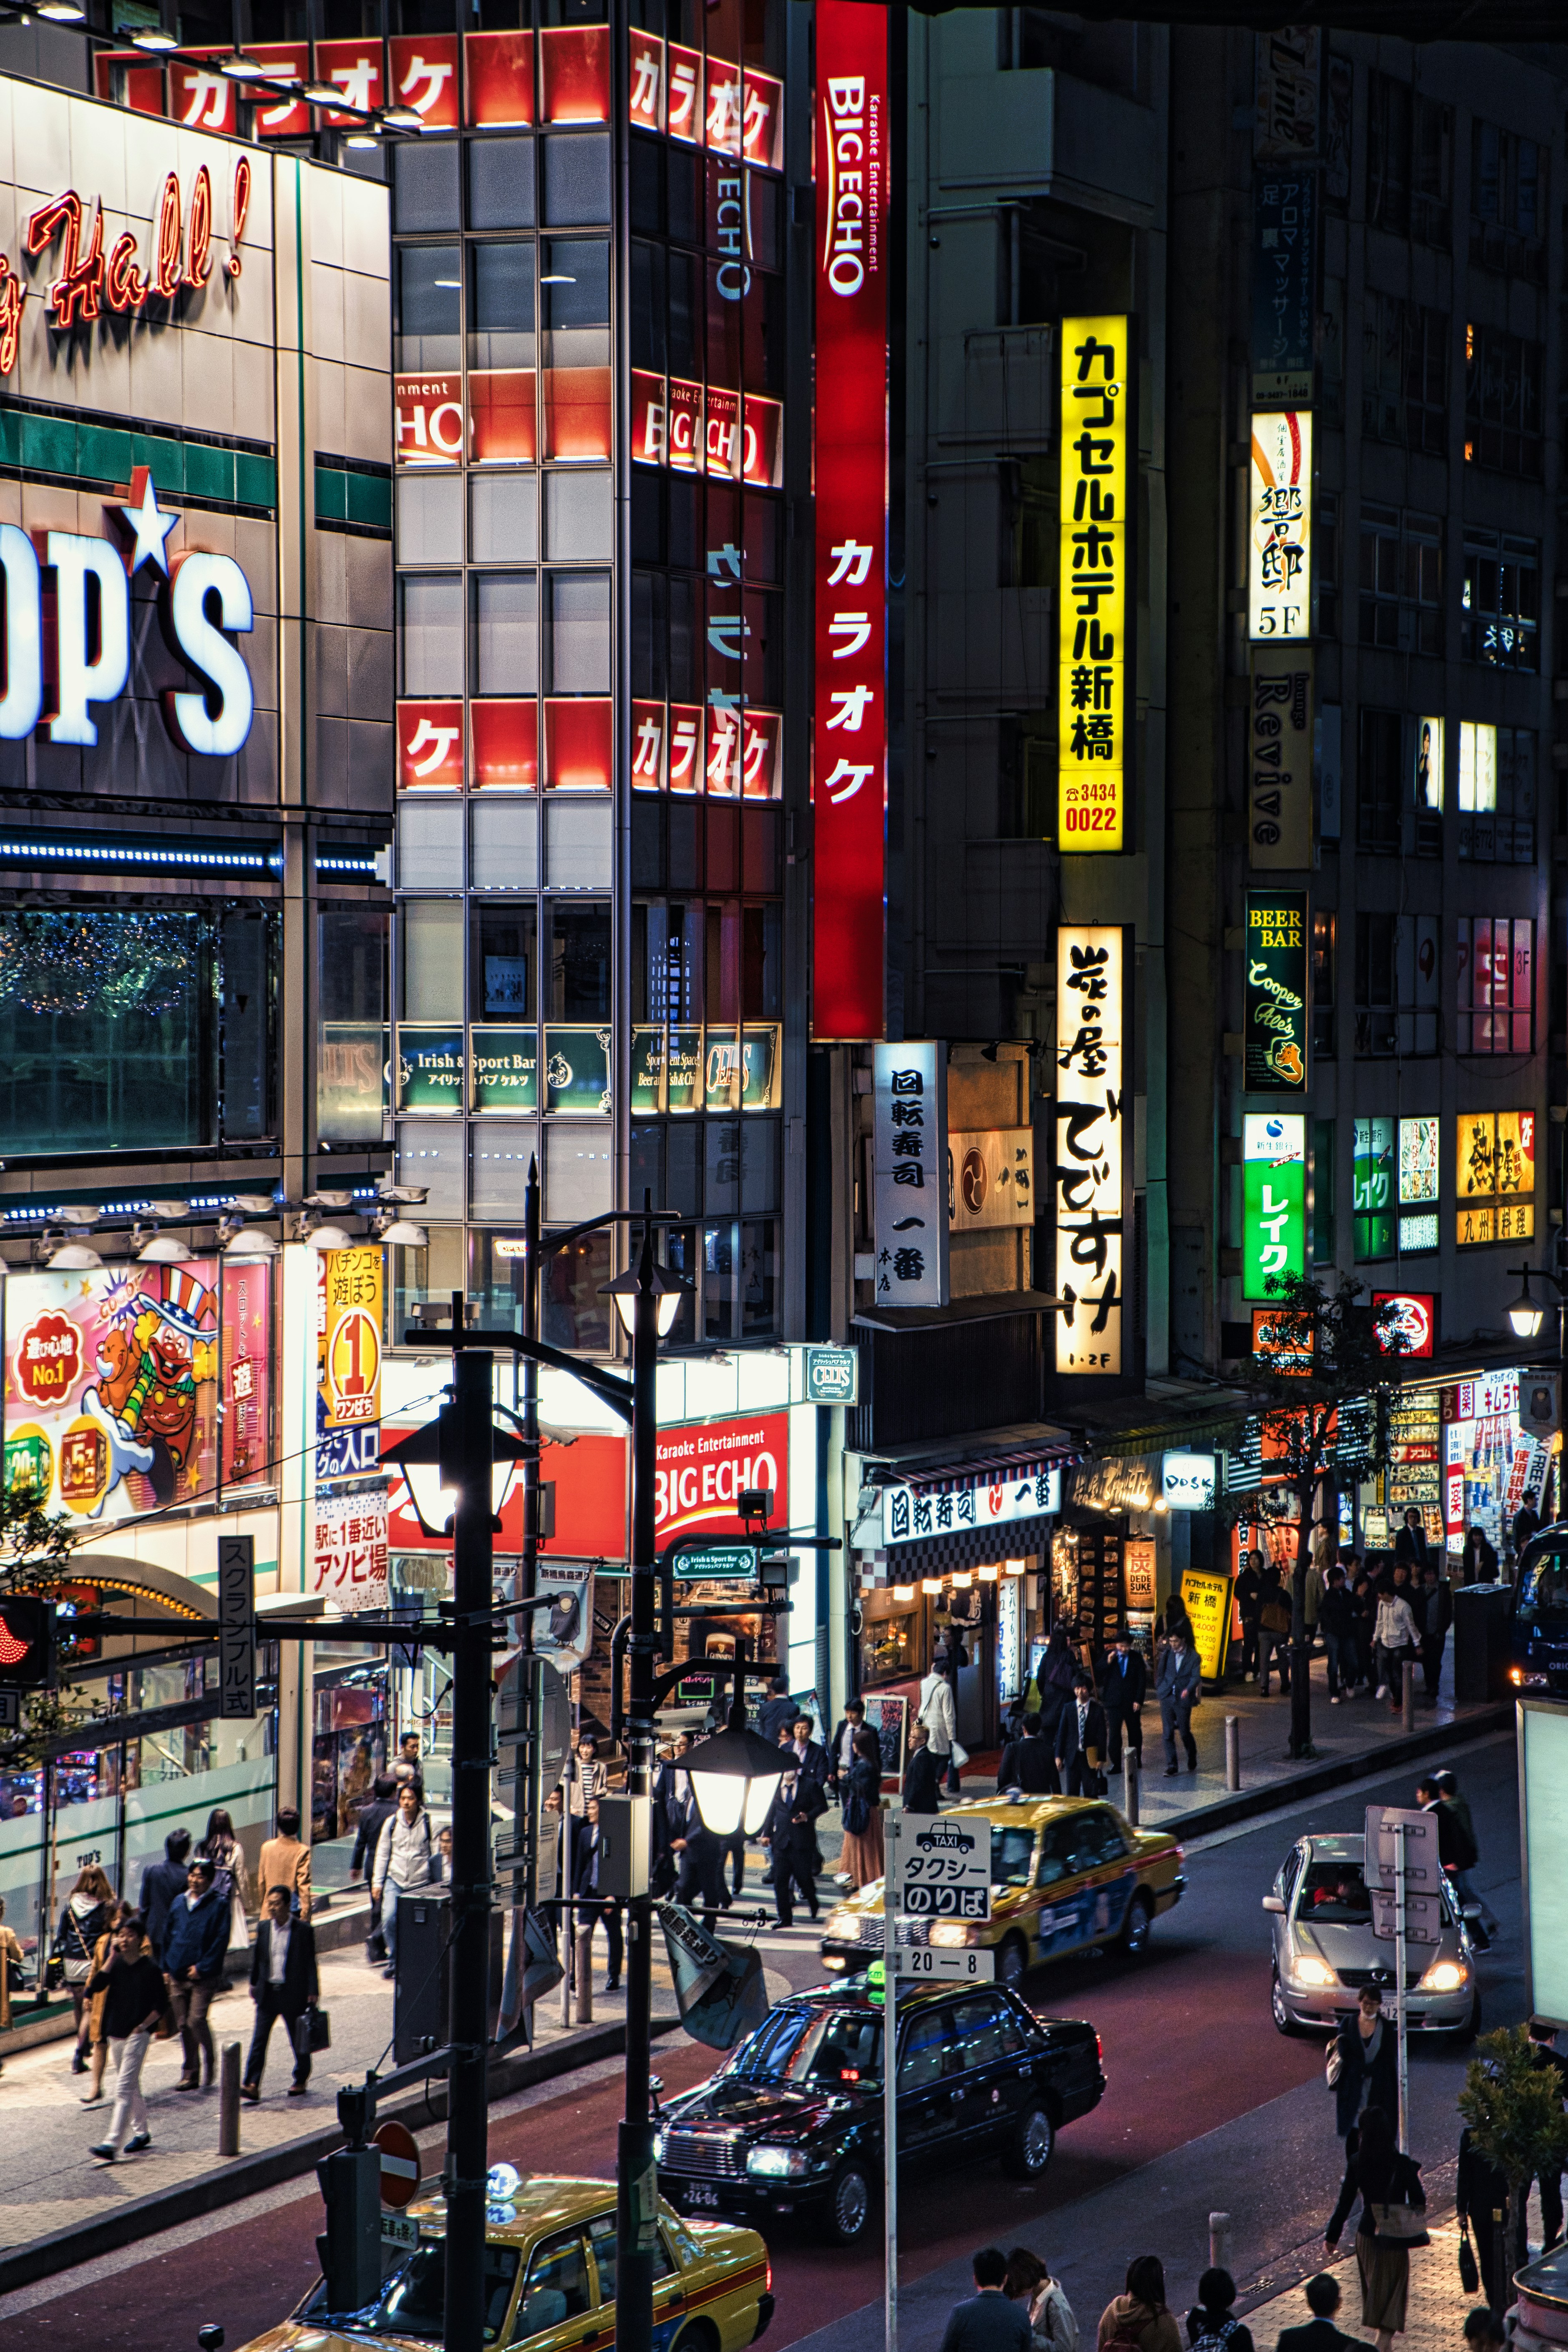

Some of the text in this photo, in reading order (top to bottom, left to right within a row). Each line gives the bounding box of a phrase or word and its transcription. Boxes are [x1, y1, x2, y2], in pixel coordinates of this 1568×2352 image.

[184, 54, 453, 128] カラオケ
[631, 51, 770, 148] カラオケ
[827, 76, 865, 297] BIG ECHO
[869, 94, 880, 272] Karaoke Entertainment
[1276, 423, 1287, 482] 個室居酒屋
[1070, 335, 1118, 761] カプセルホテル新橋
[1258, 606, 1301, 635] 5F
[825, 539, 874, 803] カラオケ
[1291, 672, 1310, 730] lounge
[407, 718, 459, 777] ケ
[634, 716, 769, 789] カラオケ
[1254, 674, 1291, 845] Revive
[1080, 783, 1116, 802] 3434
[1065, 807, 1117, 832] 0022
[1249, 909, 1303, 928] BEER
[1260, 929, 1303, 947] BAR
[1516, 950, 1530, 975] 3F
[1248, 959, 1304, 1006] Cooper
[1067, 944, 1110, 1078] 炭の屋
[418, 1053, 537, 1073] Irish & Sport Bar
[501, 1073, 529, 1087] ケルツ
[638, 1073, 653, 1087] Beer
[1256, 1141, 1293, 1151] 新生銀行
[1521, 1116, 1533, 1148] 2F
[892, 1068, 925, 1282] 回転寿司 一番
[1259, 1184, 1289, 1274] レイク
[1464, 1206, 1526, 1243] 九州料理
[329, 1251, 380, 1274] パチンコを
[878, 1247, 893, 1292] 本店
[332, 1274, 377, 1306] 遊ぼう
[343, 1313, 365, 1396] 1
[32, 1359, 65, 1386] No.1
[813, 1365, 850, 1387] CELTS
[336, 1398, 373, 1418] ワンぱち
[1461, 1383, 1472, 1413] 薬
[340, 1426, 379, 1472] 入口
[656, 1429, 765, 1462] Karaoke Entertainment
[1409, 1448, 1431, 1460] アコム
[1528, 1453, 1547, 1483] FREE
[655, 1450, 777, 1524] BIG ECHO
[1450, 1482, 1462, 1516] 薬
[891, 1489, 976, 1539] 回転寿司
[314, 1514, 387, 1550] 駅に1番近い
[313, 1543, 388, 1592] アソビ場
[710, 1556, 727, 1565] Sport
[1130, 1552, 1150, 1574] 炭
[1130, 1575, 1151, 1583] DEDE
[1130, 1583, 1151, 1591] SUKE
[1185, 1578, 1223, 1593] カプセルホテル
[1187, 1590, 1218, 1609] 新橋
[225, 1543, 248, 1712] スクランブル式
[934, 1835, 959, 1847] TAXI
[904, 1857, 987, 1880] タクシー
[906, 1886, 986, 1916] のりば
[912, 1951, 977, 1974] 20 8
